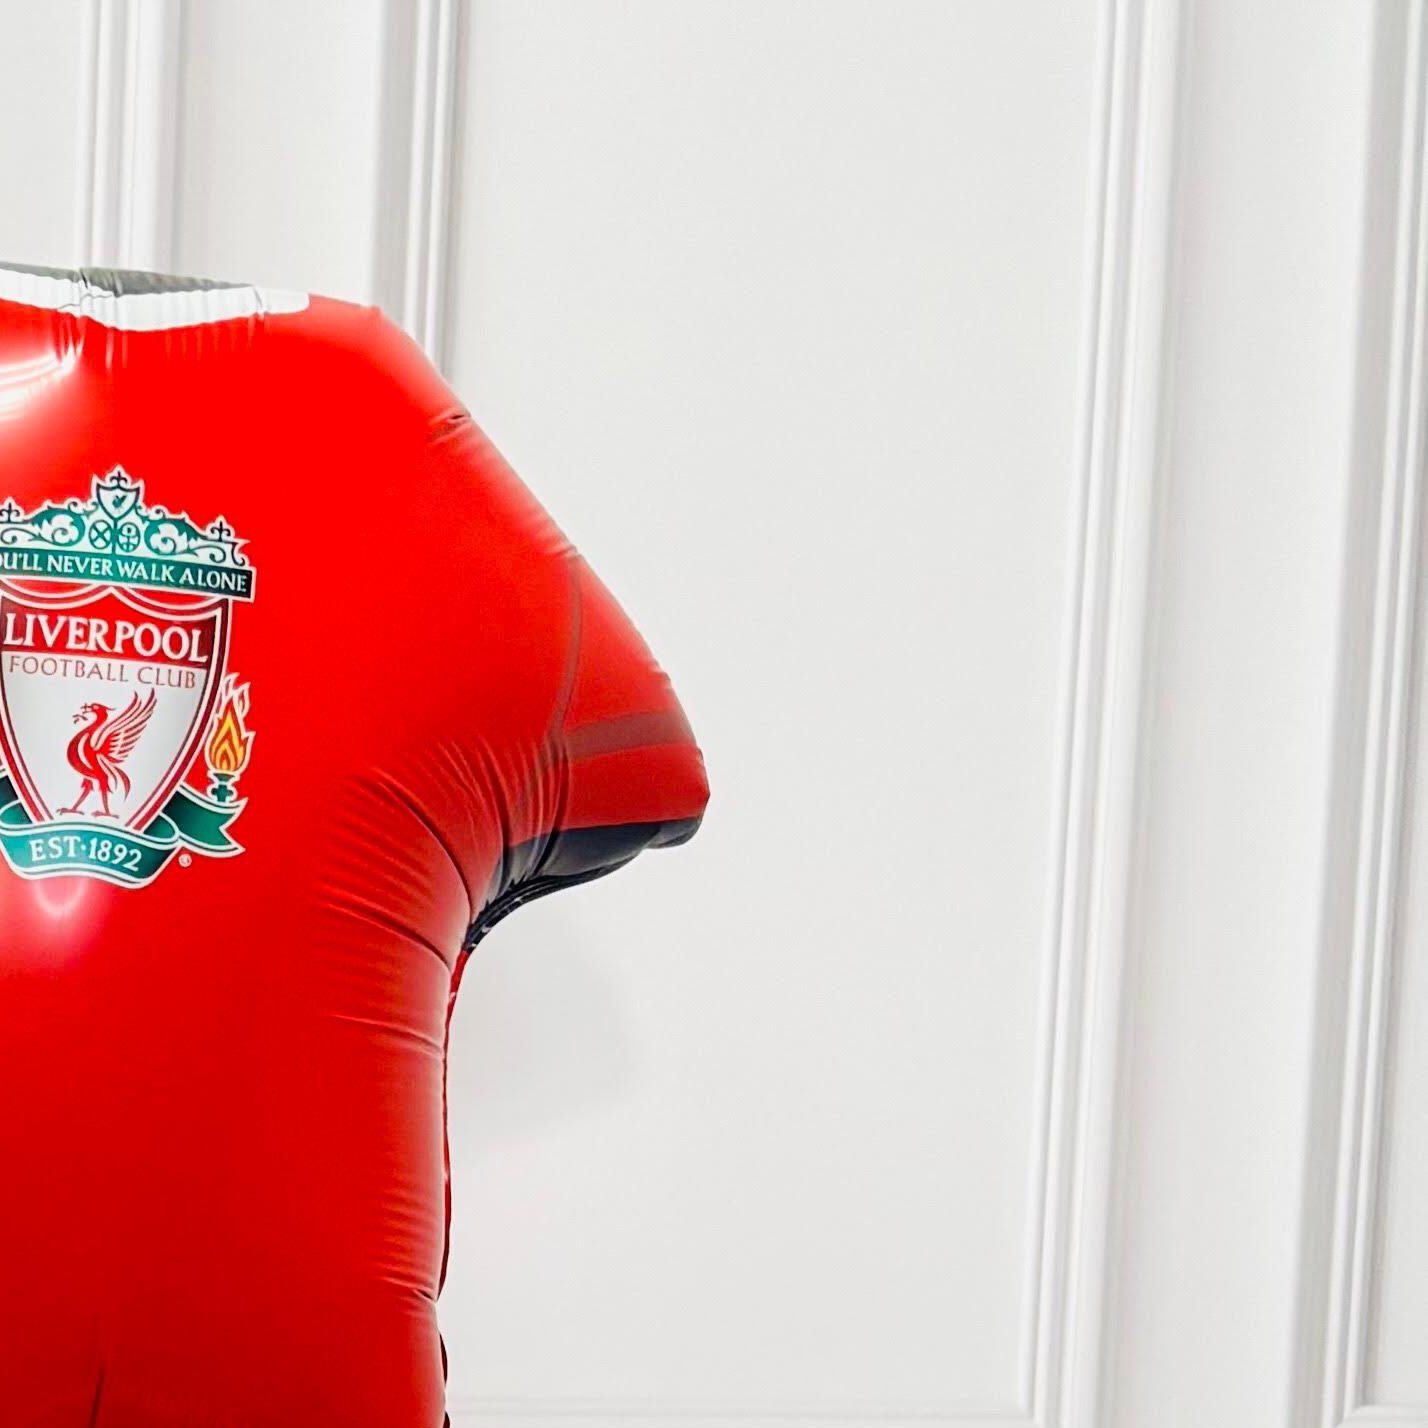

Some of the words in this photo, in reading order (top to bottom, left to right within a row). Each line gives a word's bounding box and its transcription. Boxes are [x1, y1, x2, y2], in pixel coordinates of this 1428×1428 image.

[47, 554, 113, 577] NEVER
[117, 560, 175, 583] WALK
[179, 568, 247, 593] ALONE
[3, 612, 209, 663] LIVERPOOL
[9, 655, 129, 682] FOOTBALL
[137, 666, 196, 689] CLUB
